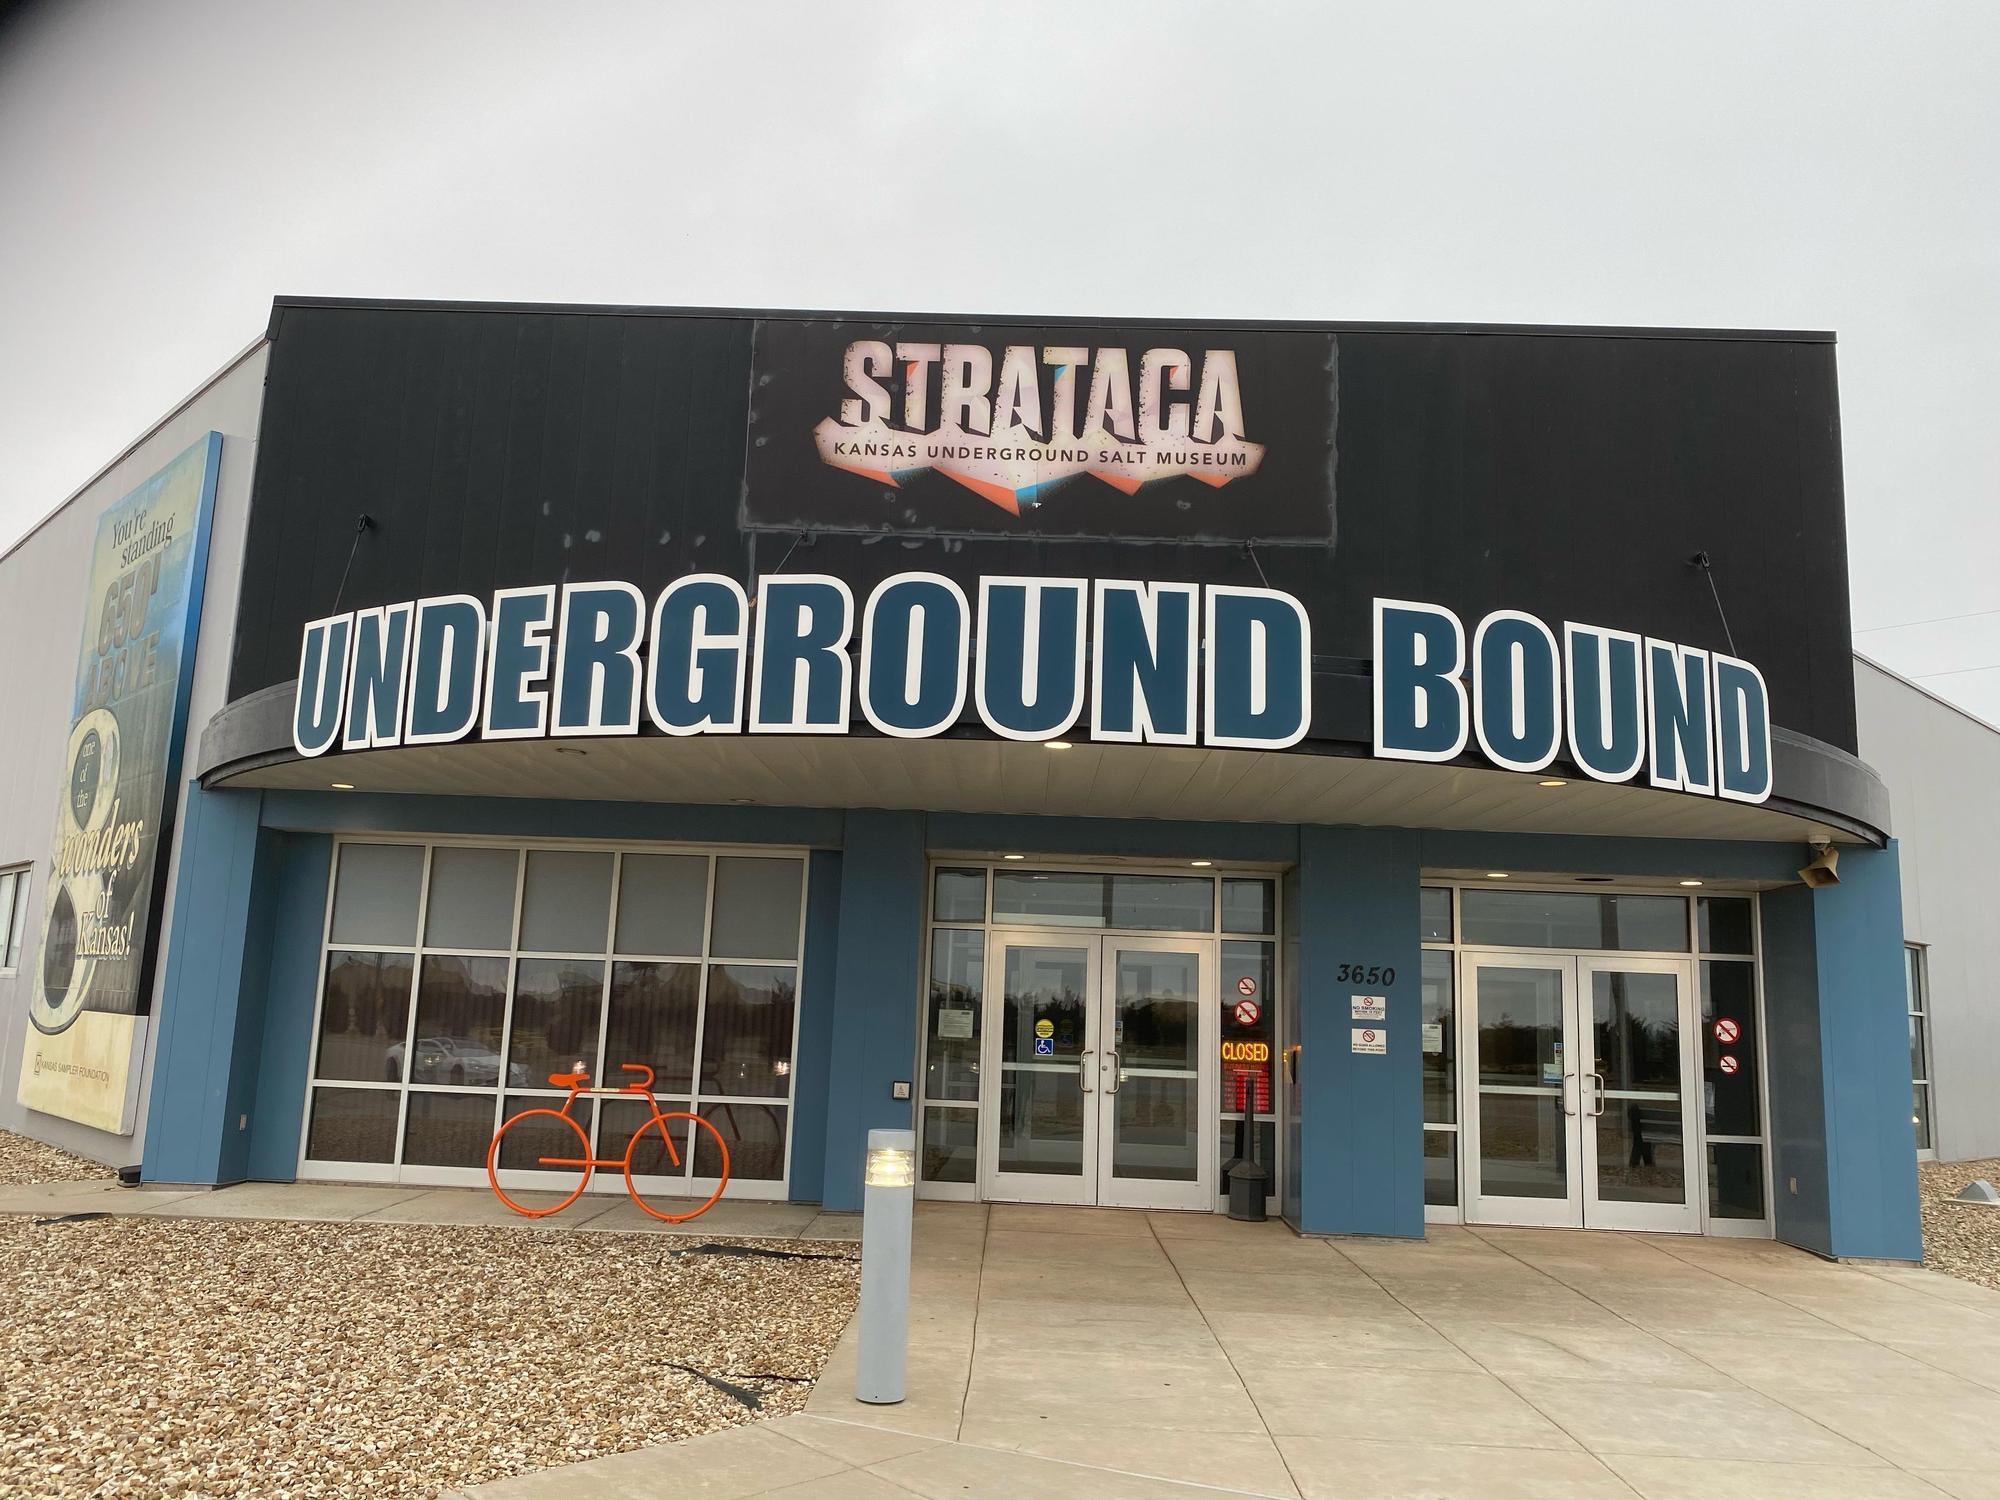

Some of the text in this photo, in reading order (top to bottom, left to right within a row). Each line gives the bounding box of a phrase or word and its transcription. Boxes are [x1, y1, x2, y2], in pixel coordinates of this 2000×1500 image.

[840, 340, 1247, 446] STRATACA
[833, 441, 1248, 467] KANSAS UNDERGROUND SALT MUSEUM
[111, 508, 147, 549] You're
[120, 512, 175, 568] standing
[293, 571, 1774, 804] UNDERGROUND BOUND
[82, 741, 96, 758] one
[79, 765, 89, 783] of
[76, 789, 89, 808] the
[59, 797, 144, 878] wonders
[95, 870, 117, 920] of
[77, 911, 136, 957] Kansas!
[1337, 964, 1396, 987] 3650
[1222, 1042, 1269, 1062] CLOSED
[79, 1066, 110, 1083] FOUNDATION
